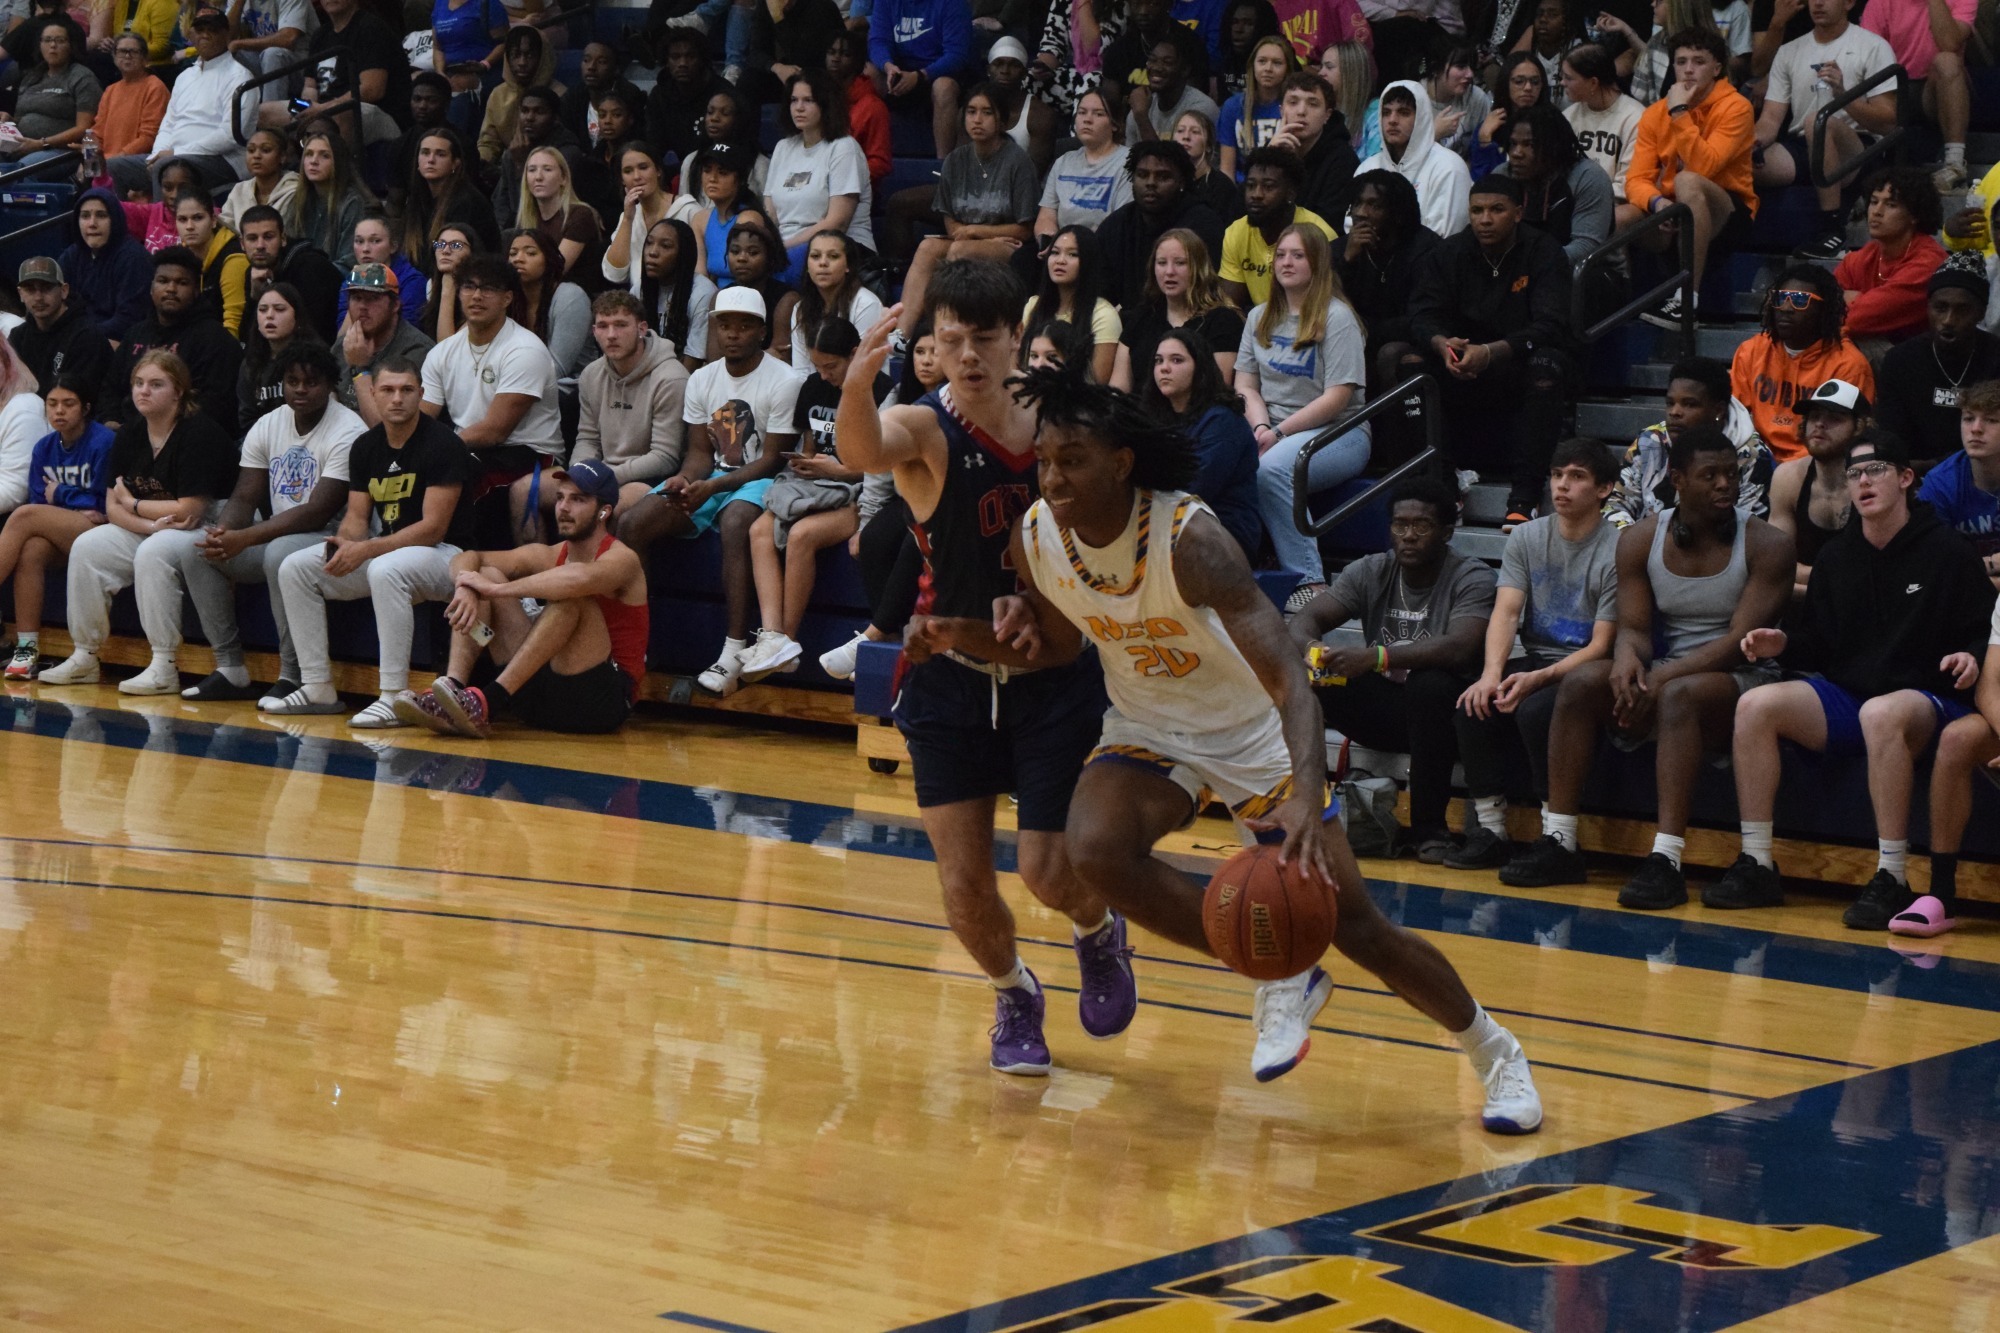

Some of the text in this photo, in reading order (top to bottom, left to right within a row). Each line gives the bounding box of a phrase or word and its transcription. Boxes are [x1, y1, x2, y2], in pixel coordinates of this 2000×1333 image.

[1235, 118, 1282, 148] NE
[1578, 130, 1623, 156] STO
[713, 143, 731, 153] NY
[368, 472, 417, 503] NEO
[1081, 614, 1189, 642] NEO
[1123, 644, 1201, 679] 20
